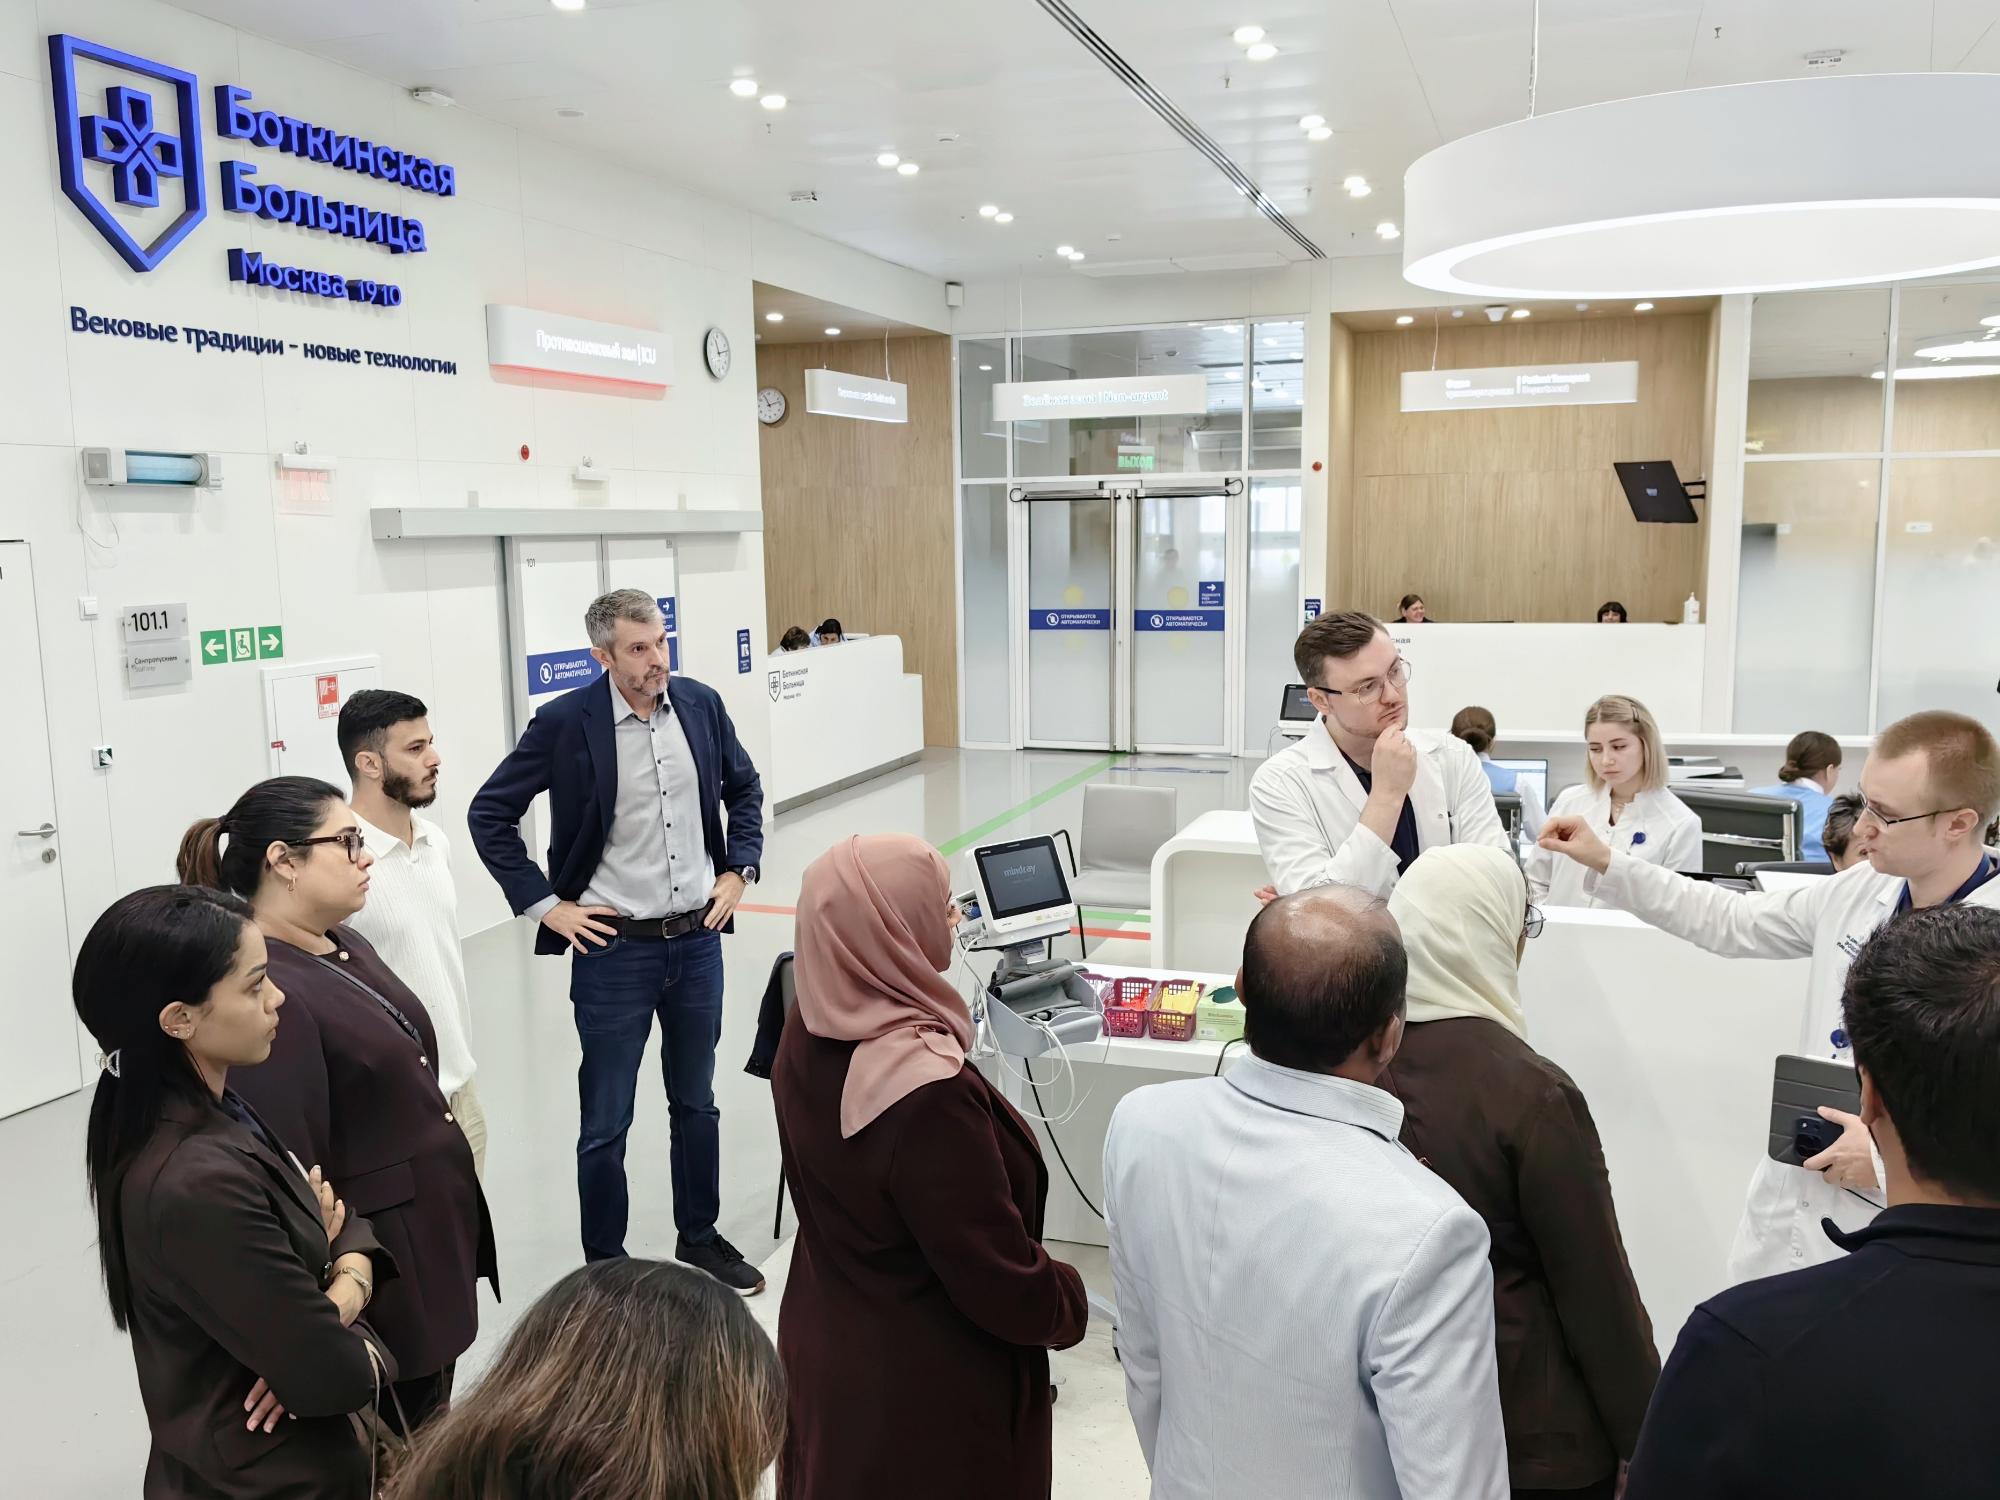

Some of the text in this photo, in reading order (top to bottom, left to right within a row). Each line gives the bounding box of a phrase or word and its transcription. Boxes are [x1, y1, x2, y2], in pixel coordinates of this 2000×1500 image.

[214, 84, 456, 197] Боткинская
[220, 160, 428, 254] Больница
[227, 248, 402, 307] Москва 1910
[69, 305, 178, 343] Вековые
[182, 326, 284, 356] традиции
[303, 342, 361, 364] новые
[364, 350, 458, 377] технологии
[131, 610, 168, 632] 101.1
[553, 659, 588, 671] ОТКРЫВАЮТСЯ
[554, 667, 592, 680] АВТОМАТИЧЕСКИ
[1003, 864, 1036, 877] mindray
